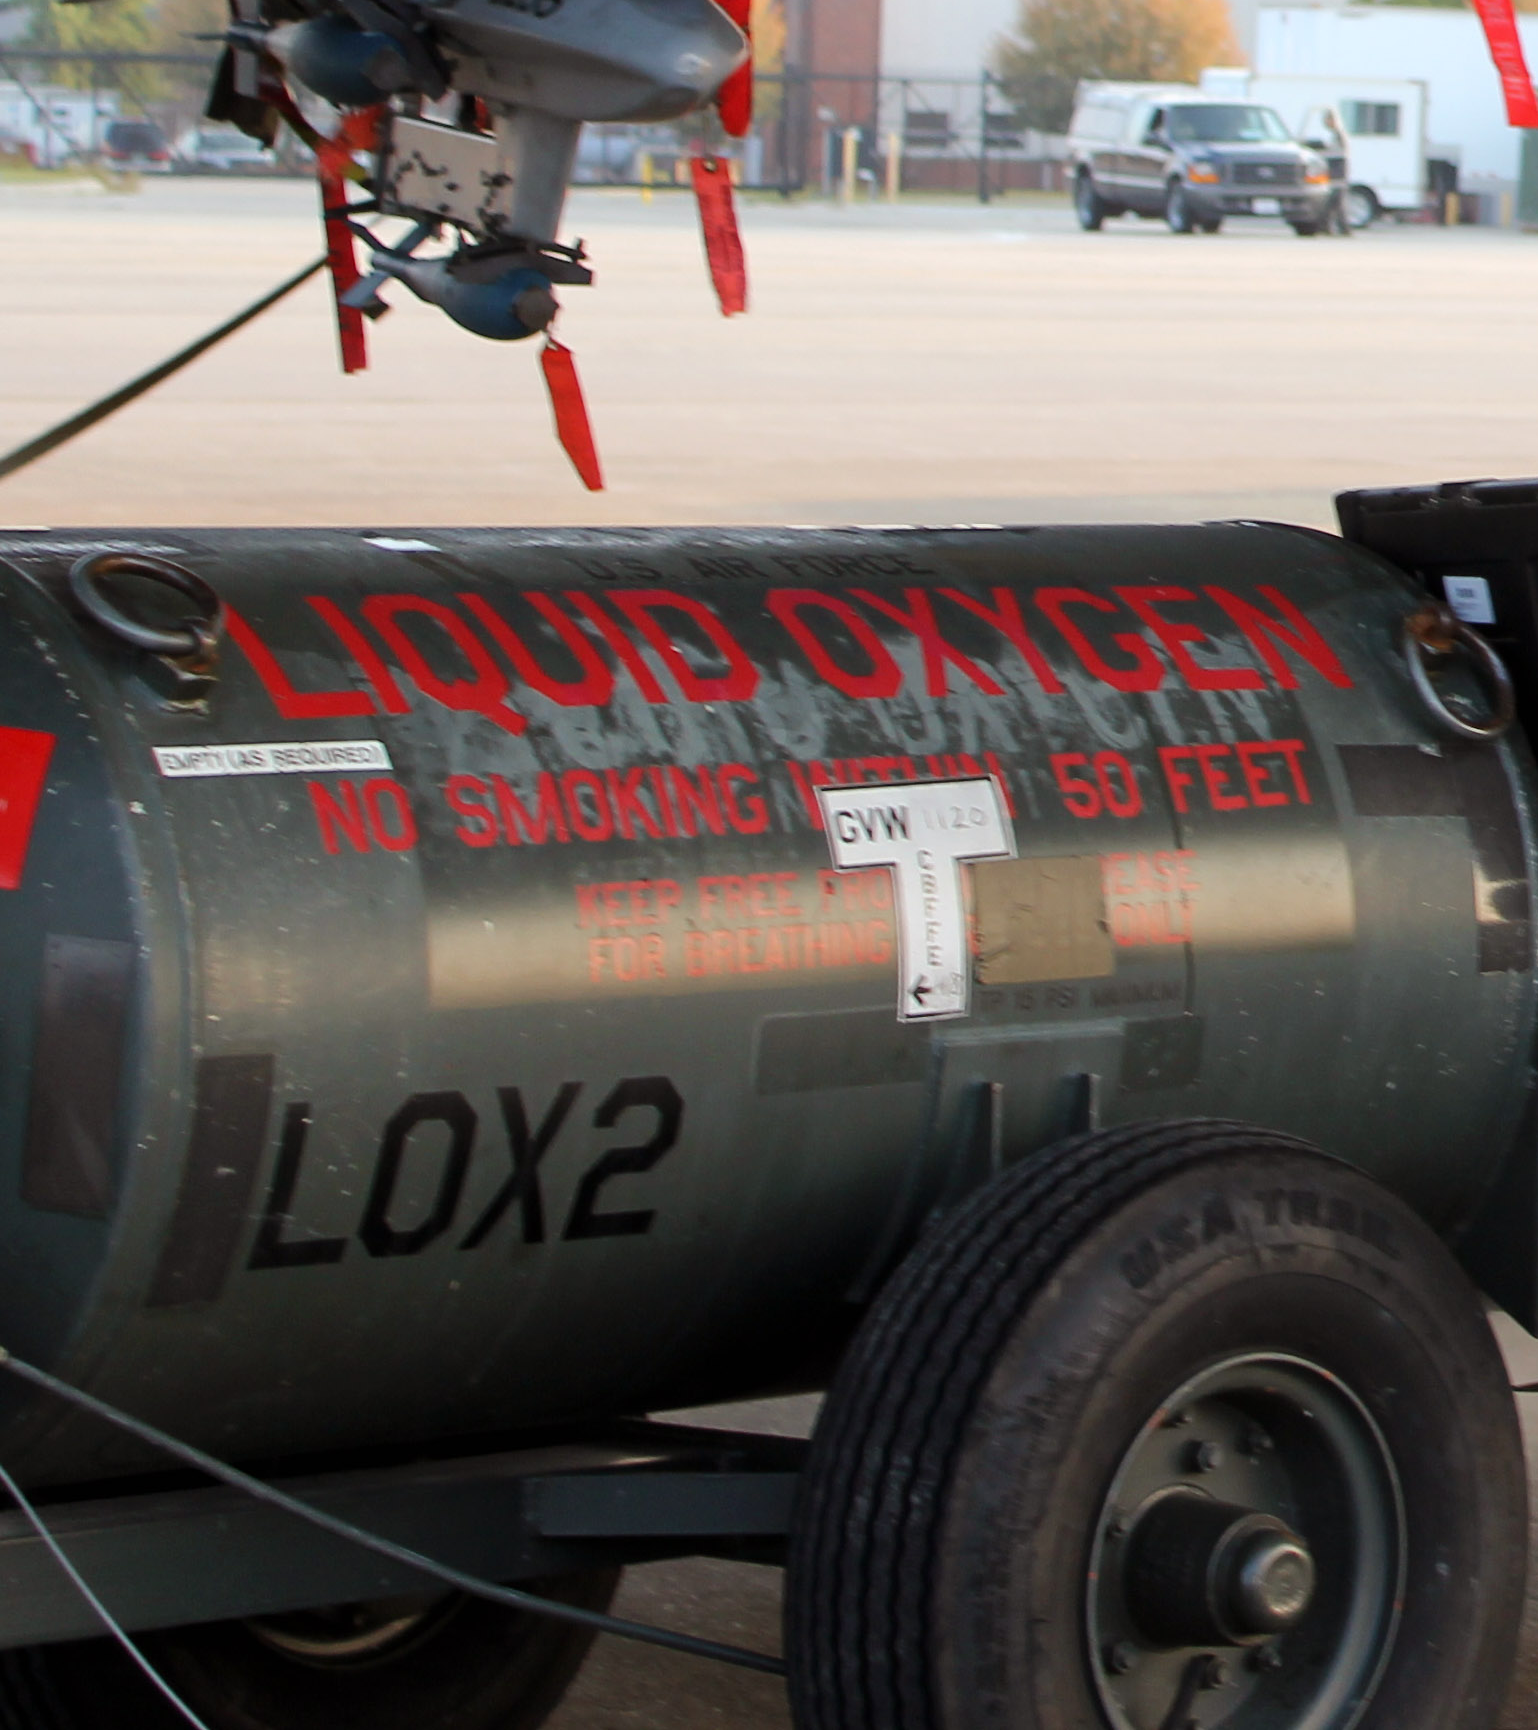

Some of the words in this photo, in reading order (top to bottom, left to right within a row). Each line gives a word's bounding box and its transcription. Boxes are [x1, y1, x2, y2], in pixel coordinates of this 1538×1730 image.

[772, 552, 936, 578] FORCE
[222, 590, 761, 738] LIQUID
[765, 583, 1355, 699] OXYGEN
[309, 778, 418, 855] NO
[444, 763, 770, 849] SMOKING
[1050, 752, 1142, 819] 50
[1159, 739, 1315, 813] FEET
[833, 804, 912, 845] GVW
[574, 878, 683, 930] KEEP
[697, 873, 804, 922] FREE
[820, 869, 894, 913] FRO
[1102, 851, 1203, 895] EASE
[589, 933, 666, 983] FOR
[685, 920, 894, 980] BREATHING
[1114, 900, 1196, 949] ONLY
[246, 1075, 685, 1270] LOX2
